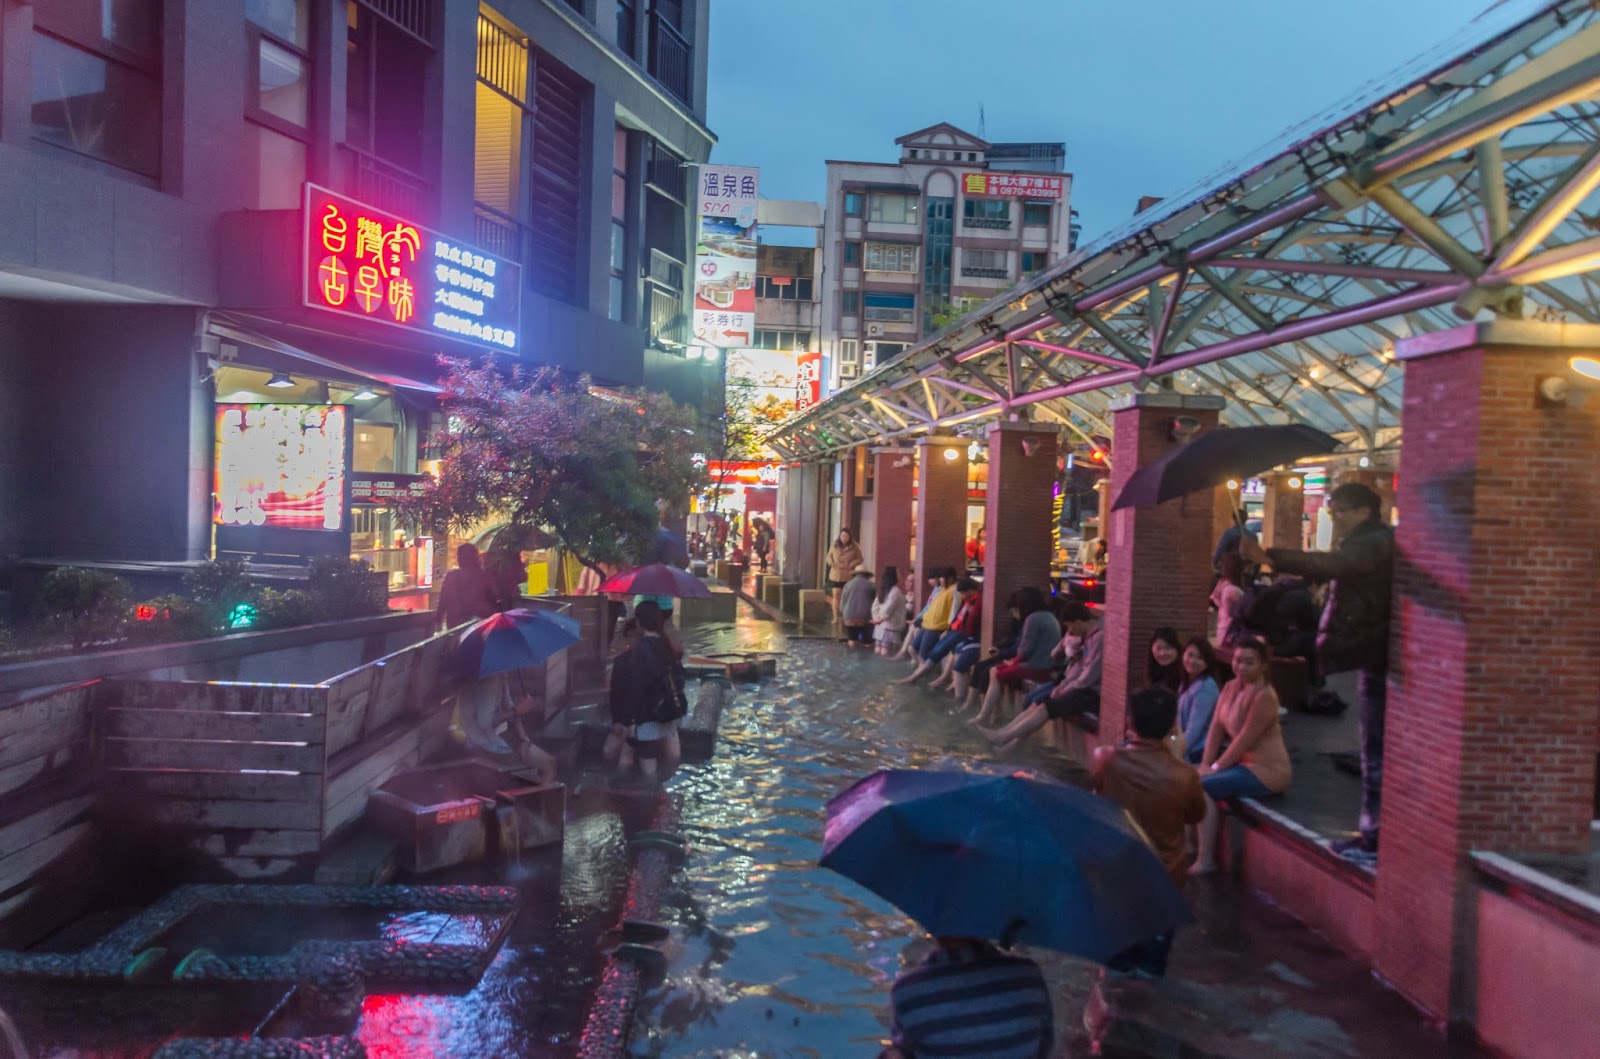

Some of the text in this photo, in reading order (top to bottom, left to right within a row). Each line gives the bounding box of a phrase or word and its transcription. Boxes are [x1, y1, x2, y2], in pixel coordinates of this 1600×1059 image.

[703, 172, 756, 200] 溫泉魚
[703, 201, 731, 213] SPA
[322, 204, 383, 264] 台灣
[319, 254, 414, 323] 古早味
